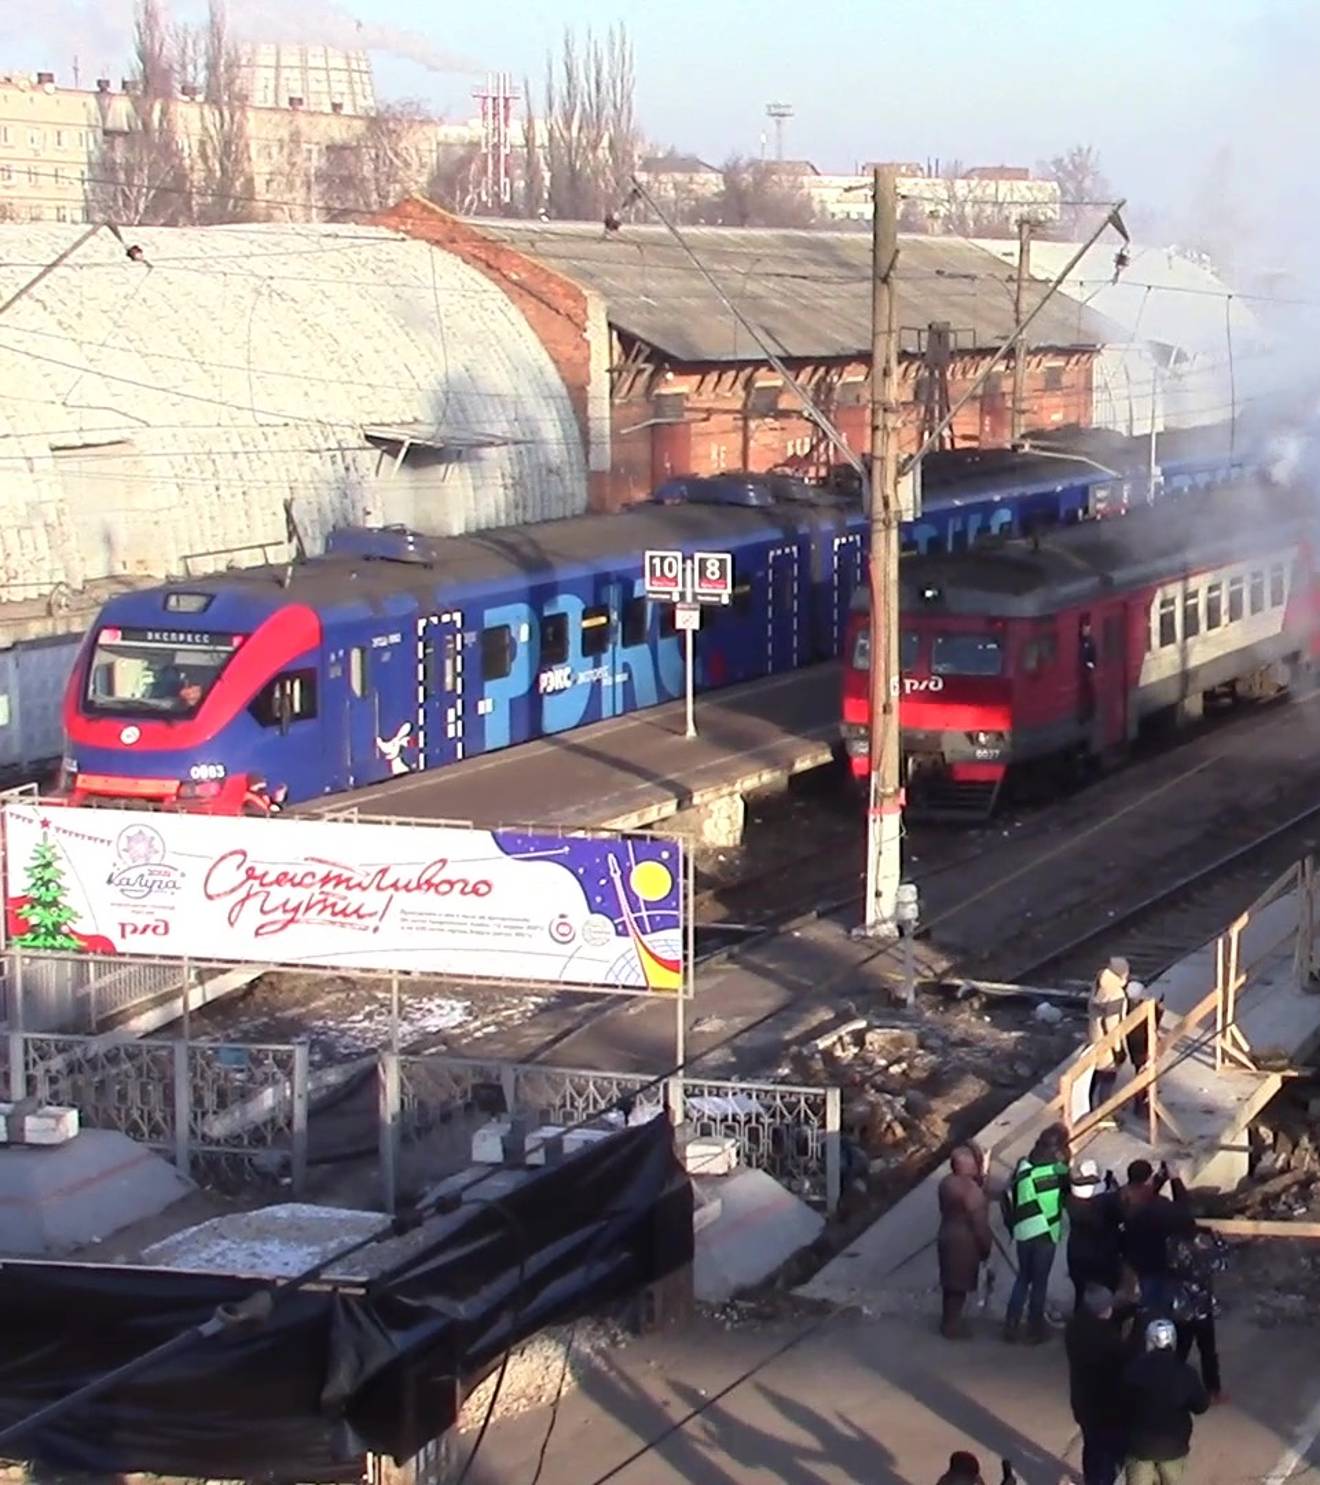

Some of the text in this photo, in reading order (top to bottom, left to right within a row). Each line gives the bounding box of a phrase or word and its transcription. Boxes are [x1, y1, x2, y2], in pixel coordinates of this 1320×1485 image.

[652, 557, 678, 578] 10
[705, 558, 721, 580] 8
[146, 631, 210, 643] ЭКСПРЕСС
[106, 871, 182, 899] Калуга
[203, 848, 494, 899] Счастливого
[227, 884, 395, 938] Пути!
